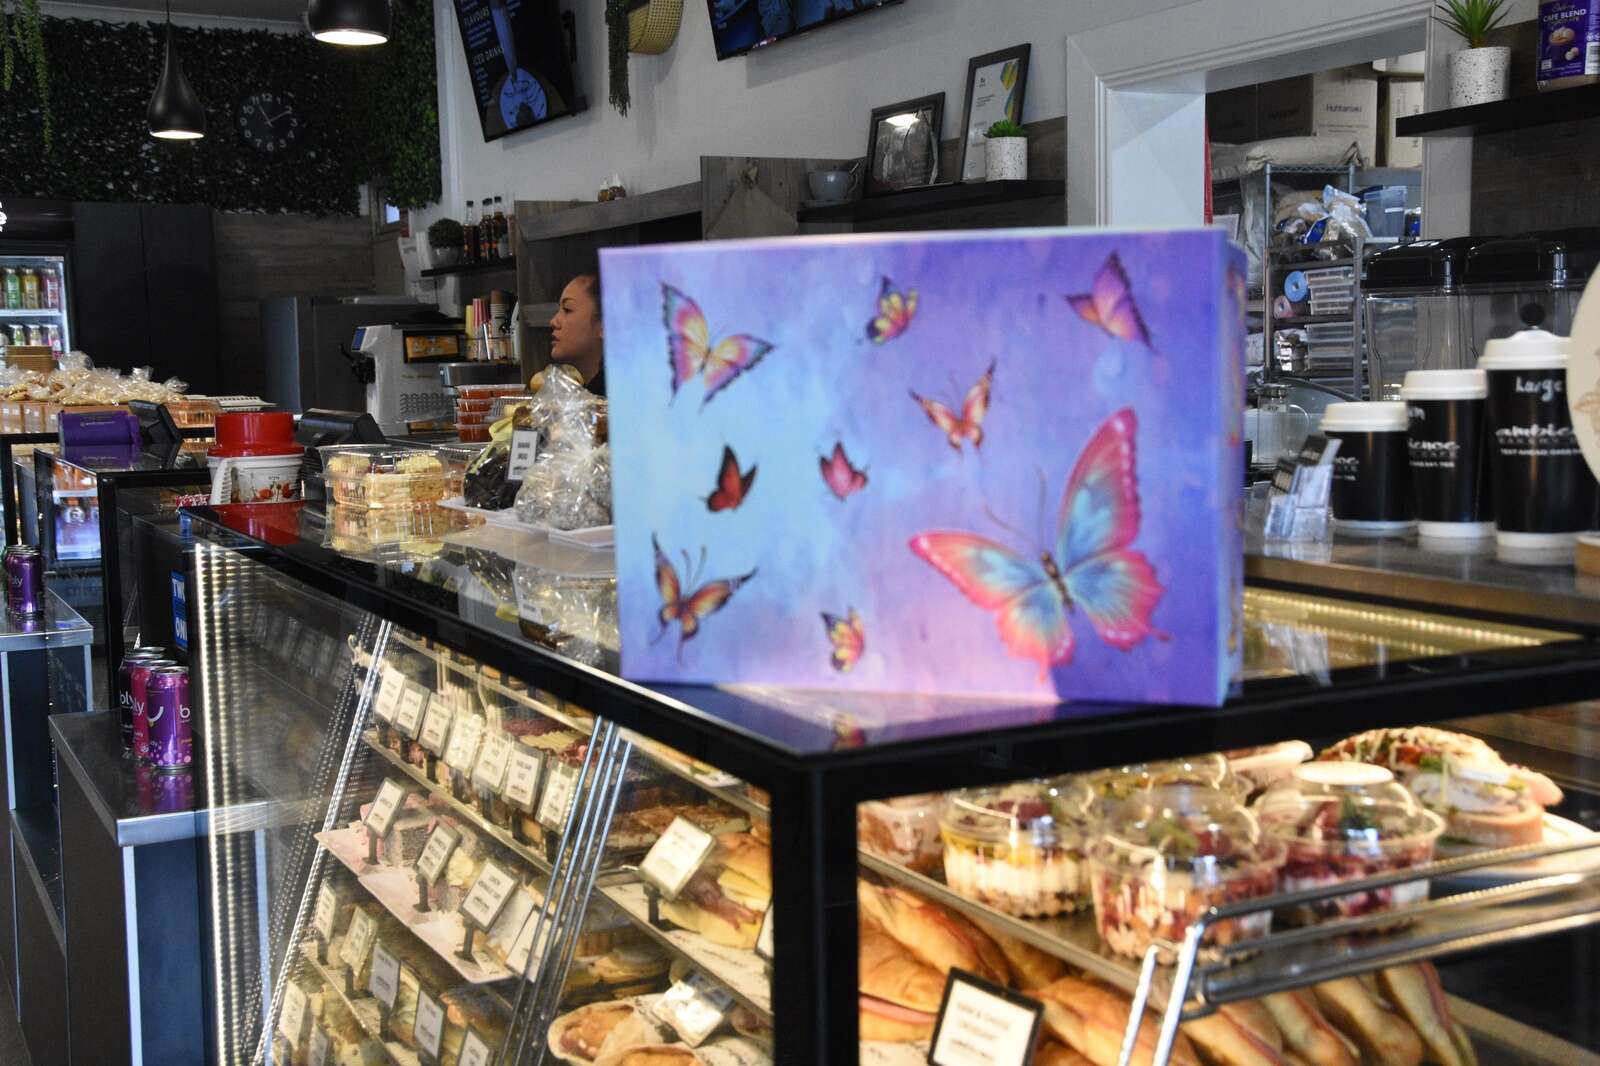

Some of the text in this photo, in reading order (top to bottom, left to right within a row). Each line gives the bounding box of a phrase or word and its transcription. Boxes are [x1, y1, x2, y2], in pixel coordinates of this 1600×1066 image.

[1560, 9, 1587, 18] BLEND
[251, 96, 260, 105] 11
[262, 93, 272, 102] 12
[242, 105, 254, 115] 10
[285, 105, 293, 114] 2
[240, 117, 247, 127] 9
[290, 118, 298, 127] 3
[244, 129, 252, 138] 8
[288, 130, 295, 138] 4
[255, 138, 262, 148] 7
[266, 142, 274, 152] 6
[279, 139, 287, 148] 5
[1515, 376, 1563, 402] Large
